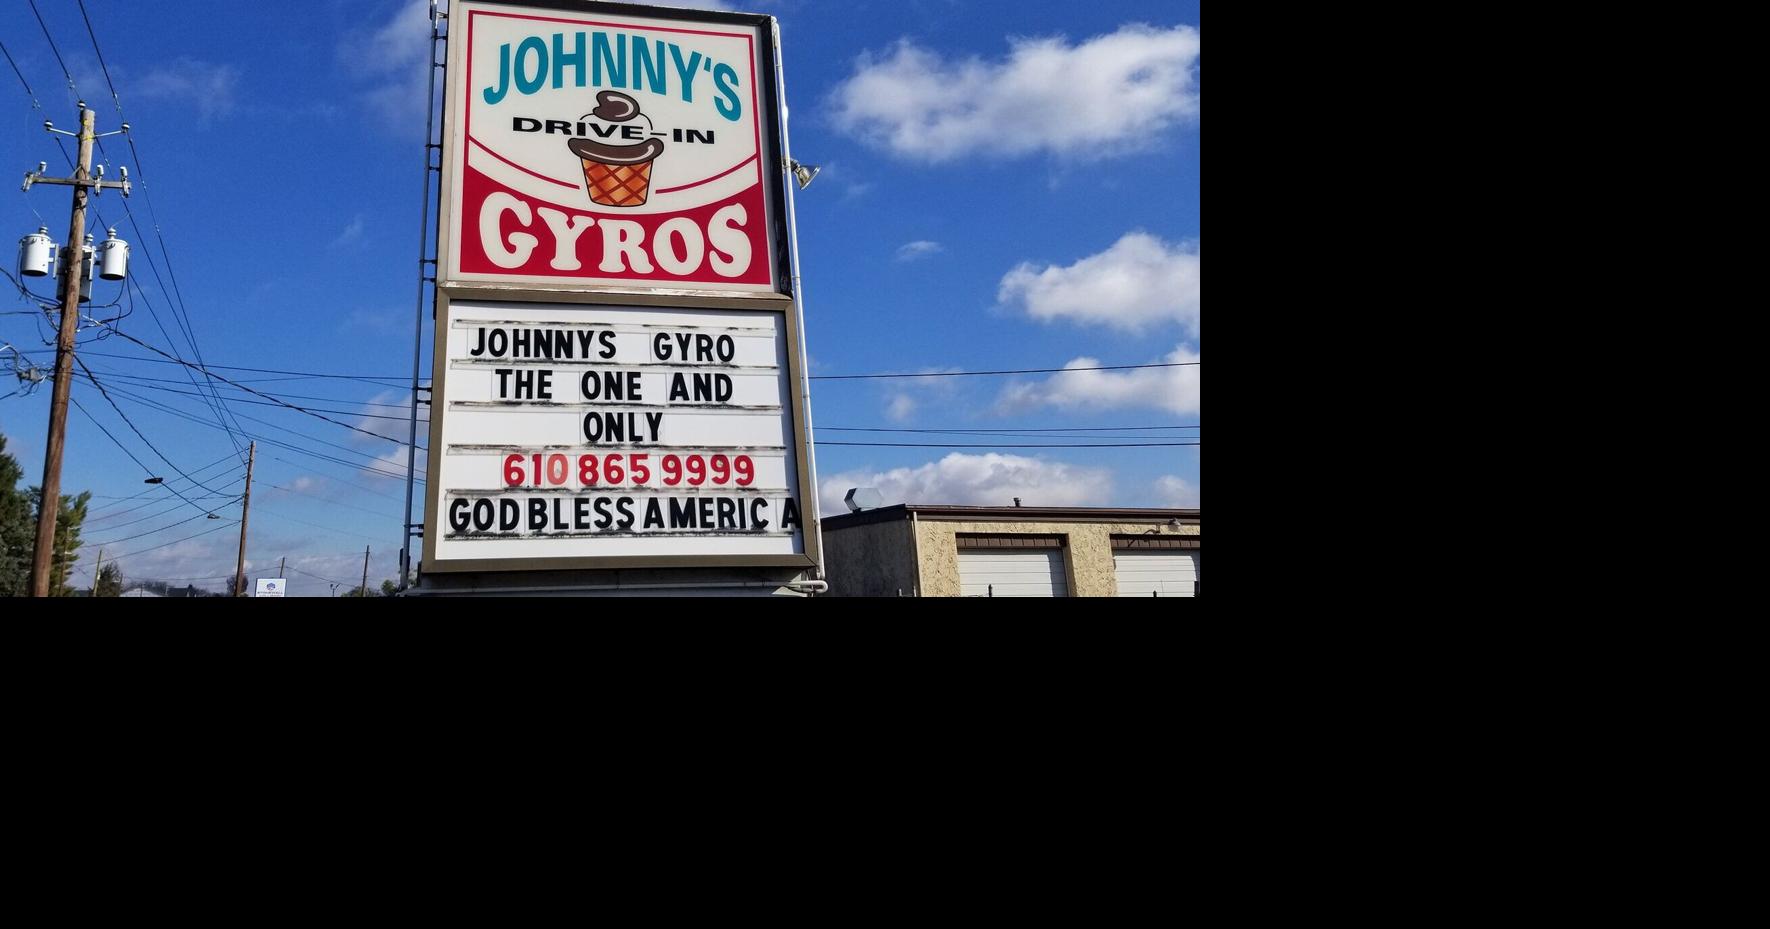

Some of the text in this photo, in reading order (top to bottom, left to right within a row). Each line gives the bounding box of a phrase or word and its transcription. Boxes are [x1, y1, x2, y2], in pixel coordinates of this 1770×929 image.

[483, 32, 742, 122] JOHNNY'S
[512, 117, 715, 144] DRIVE-IN
[479, 191, 752, 278] GYROS
[470, 327, 735, 362] JOHNNYS GYRO
[495, 368, 733, 402] THE ONE AND
[583, 411, 663, 442] ONLY
[503, 453, 755, 487] 610 865 9999
[449, 498, 520, 531] GOD
[528, 497, 635, 530] BLESS
